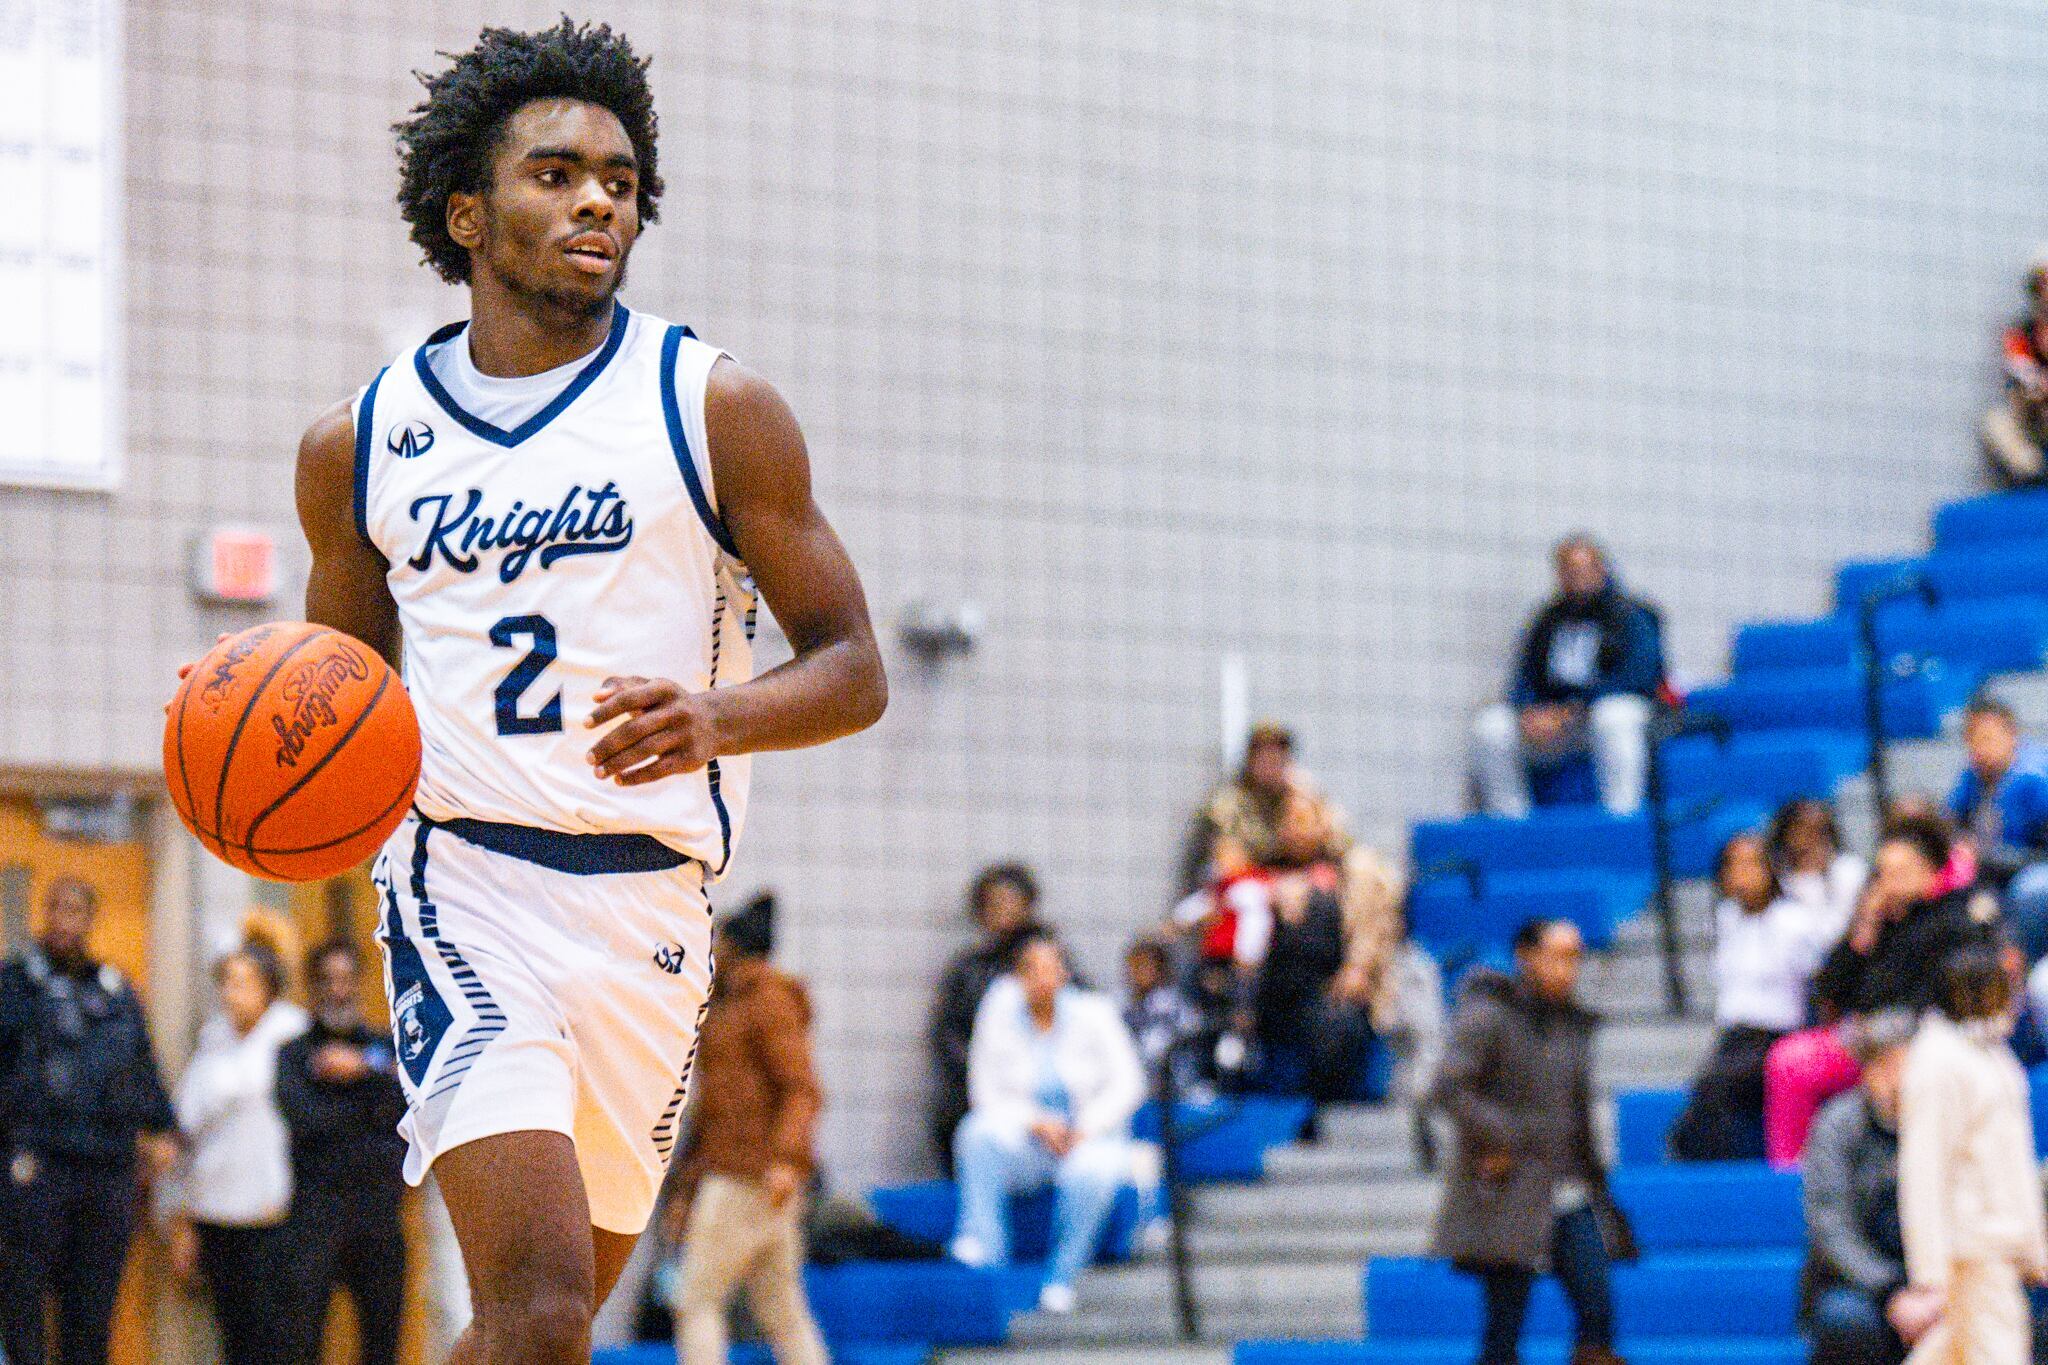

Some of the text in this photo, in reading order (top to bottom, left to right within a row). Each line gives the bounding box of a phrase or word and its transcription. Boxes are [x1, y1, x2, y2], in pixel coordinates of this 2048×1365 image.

[408, 481, 634, 584] Knights
[272, 642, 369, 768] Rawlings
[489, 614, 563, 736] 2
